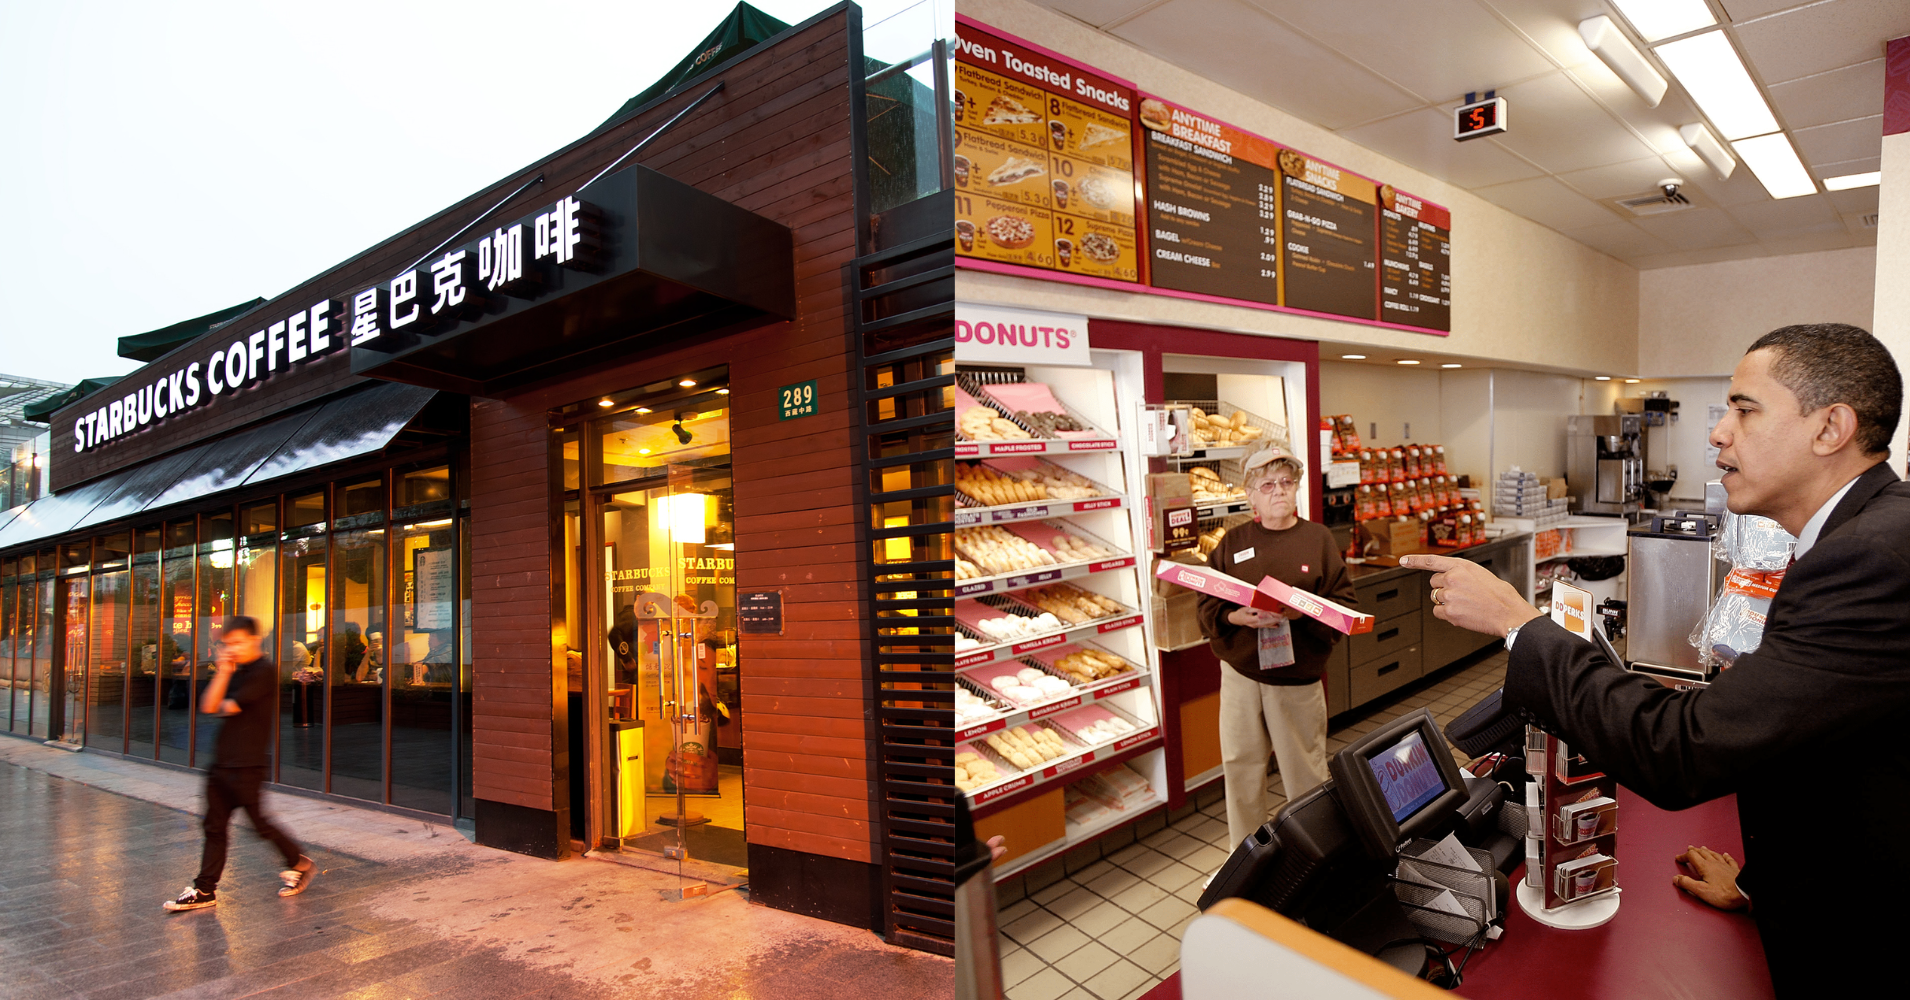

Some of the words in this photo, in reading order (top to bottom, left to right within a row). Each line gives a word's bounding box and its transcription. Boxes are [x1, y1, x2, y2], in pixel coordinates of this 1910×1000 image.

[959, 66, 1001, 86] Flatbread
[1004, 82, 1043, 100] Sandwich
[1002, 50, 1071, 90] Toasted
[1076, 78, 1130, 111] Snacks
[1050, 98, 1061, 115] 8
[1171, 109, 1221, 137] ANYTIME
[964, 132, 1005, 151] Flatbread
[1008, 144, 1046, 161] Sandwich
[1172, 123, 1232, 153] BREAKFAST
[1151, 130, 1193, 151] BREAKFAST
[1193, 144, 1233, 165] SANDWICH
[1053, 157, 1073, 177] 10
[1305, 159, 1340, 181] ANYTIME
[1305, 171, 1338, 191] SNACKS
[986, 199, 1028, 215] Pepperoni
[1030, 208, 1050, 220] Pizza
[1153, 200, 1176, 214] HASH
[1177, 206, 1210, 222] BROWNS
[1395, 202, 1419, 219] BAKERY
[1056, 217, 1074, 235] 12
[1086, 221, 1116, 233] Supreme
[1321, 219, 1338, 231] PIZZA
[1155, 229, 1180, 243] BAGEL
[1287, 242, 1309, 254] COOKIE
[1156, 248, 1183, 262] CREAM
[1184, 254, 1210, 267] CHEESE
[350, 195, 581, 347] 星巴克咖啡
[74, 362, 200, 453] STARBUCKS
[207, 299, 331, 396] COFFEE
[783, 385, 812, 408] 289
[994, 444, 1015, 452] MAPLE
[678, 558, 734, 570] STARBU
[1101, 560, 1125, 569] SUGARED
[605, 567, 670, 581] STARBUCKS
[719, 577, 735, 585] COM
[1038, 573, 1052, 581] JELLY
[962, 584, 986, 593] GLAZED
[1563, 604, 1585, 621] PERKS
[1019, 640, 1042, 650] VANILLA
[1042, 635, 1062, 646] KREME
[970, 654, 989, 664] KREME
[1060, 699, 1079, 709] KREME
[964, 726, 987, 737] LEMON
[1120, 737, 1138, 747] LEMON
[983, 785, 1003, 799] APPLE
[1003, 779, 1026, 792] CRUMB
